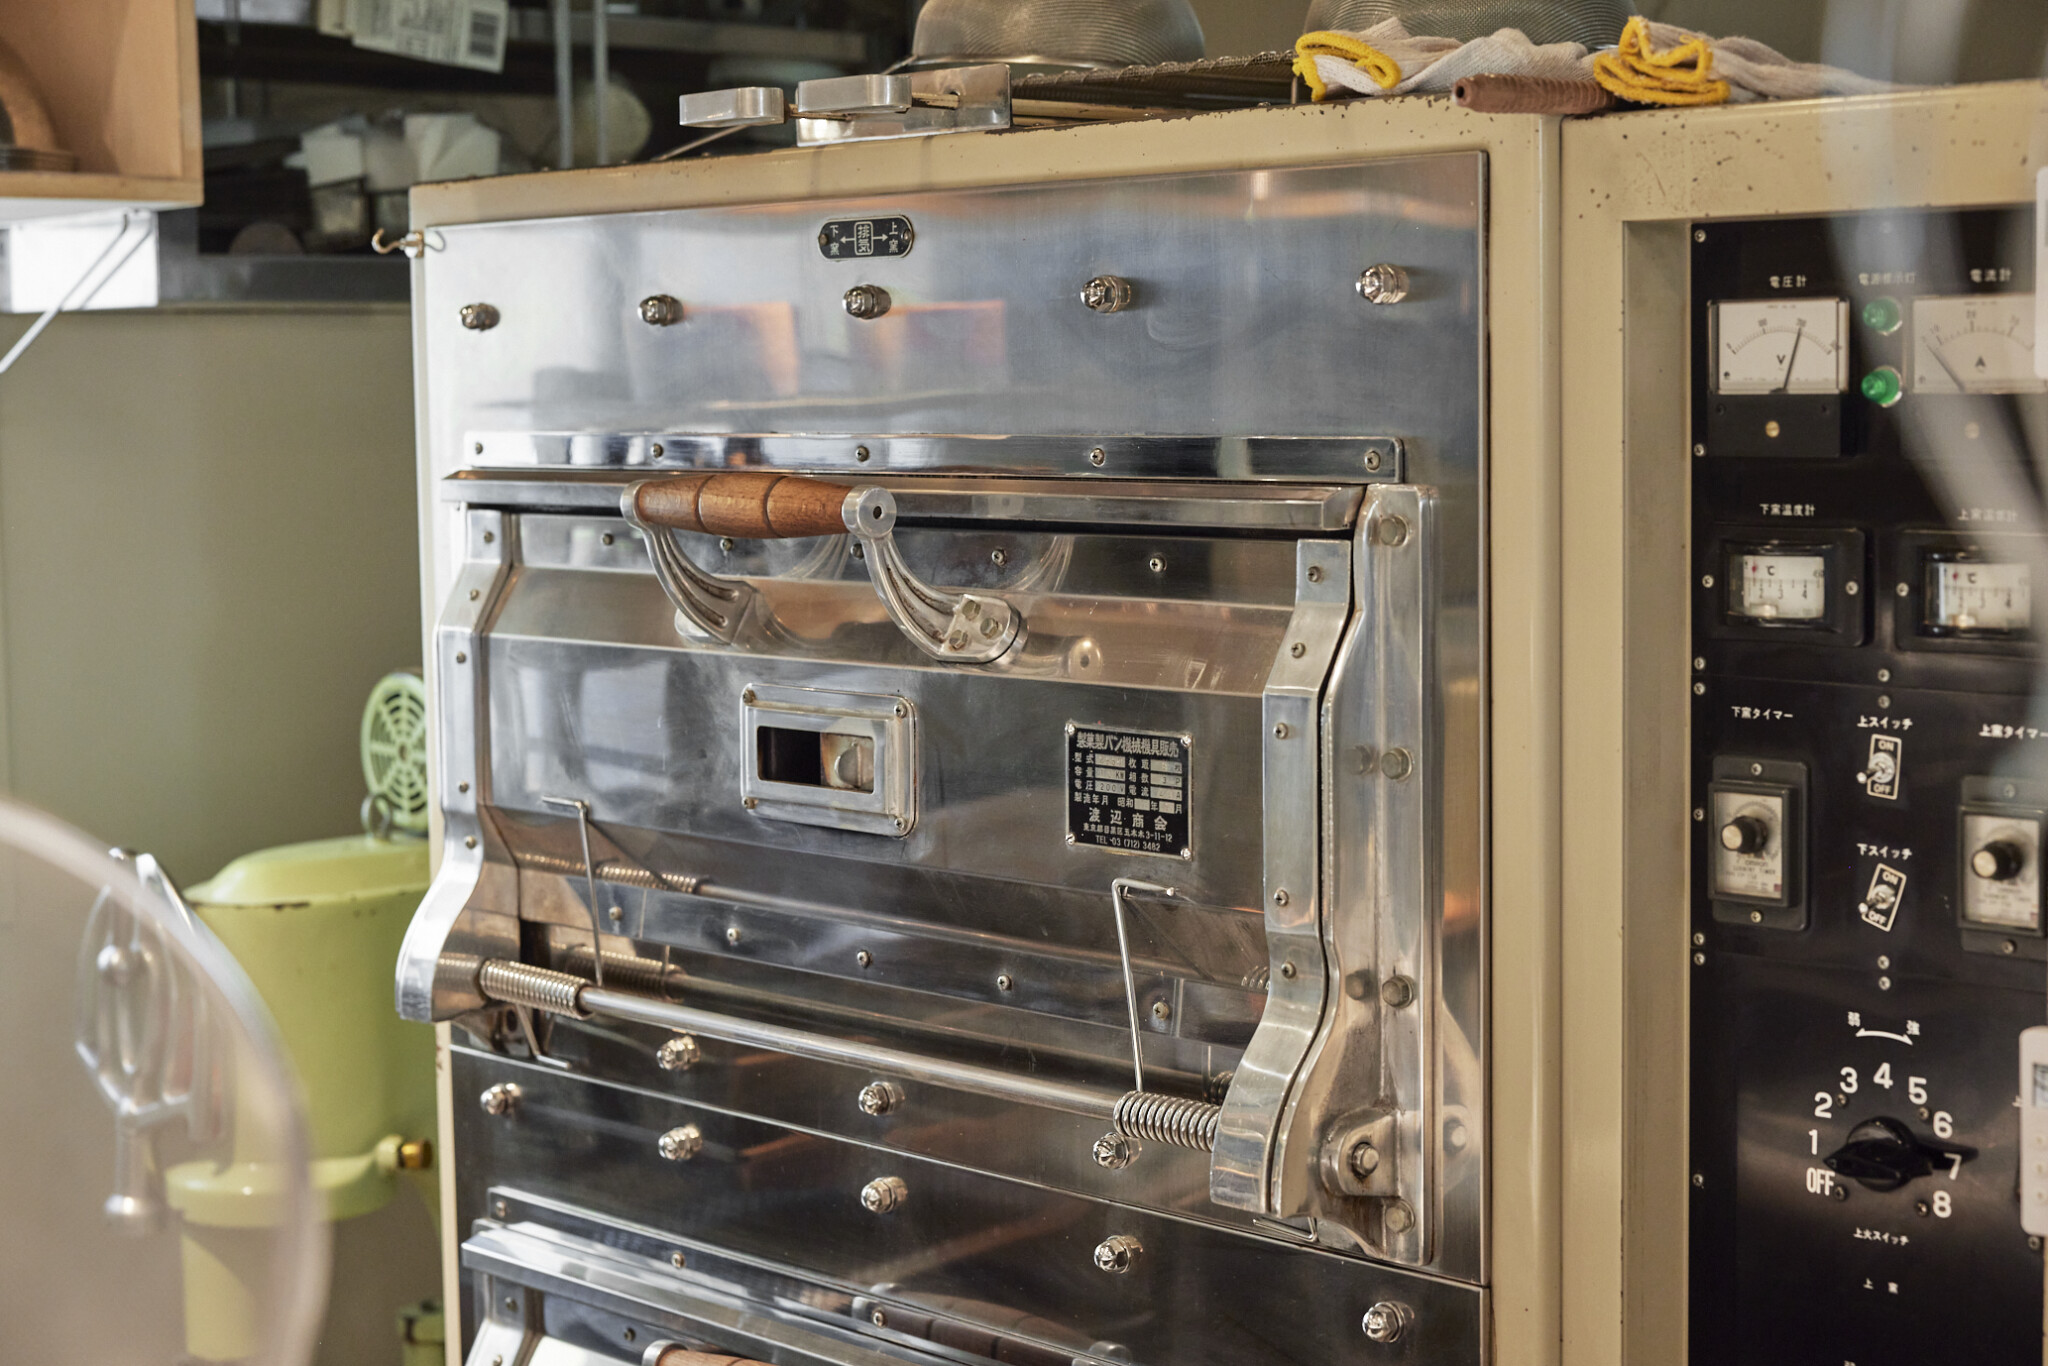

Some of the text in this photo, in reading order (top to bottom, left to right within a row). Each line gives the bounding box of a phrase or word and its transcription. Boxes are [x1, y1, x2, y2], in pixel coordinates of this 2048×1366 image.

[1769, 275, 1807, 289] 電圧計
[1777, 354, 1786, 364] V
[1975, 356, 1985, 367] A
[1856, 715, 1913, 732] 上スイッチ
[1879, 739, 1895, 752] ON
[1873, 783, 1892, 795] OFF
[1096, 834, 1108, 845] TEL
[1856, 843, 1913, 860] 下スイッチ
[1882, 870, 1899, 885] ON
[1868, 911, 1888, 927] OFF
[1840, 1066, 1858, 1094] 3
[1873, 1063, 1893, 1089] 4
[1908, 1077, 1928, 1105] 5
[1814, 1091, 1833, 1119] 2
[1932, 1110, 1953, 1139] 6
[1808, 1128, 1819, 1155] 1
[1943, 1153, 1963, 1180] 7
[1806, 1167, 1836, 1196] OFF
[1932, 1190, 1952, 1218] 8
